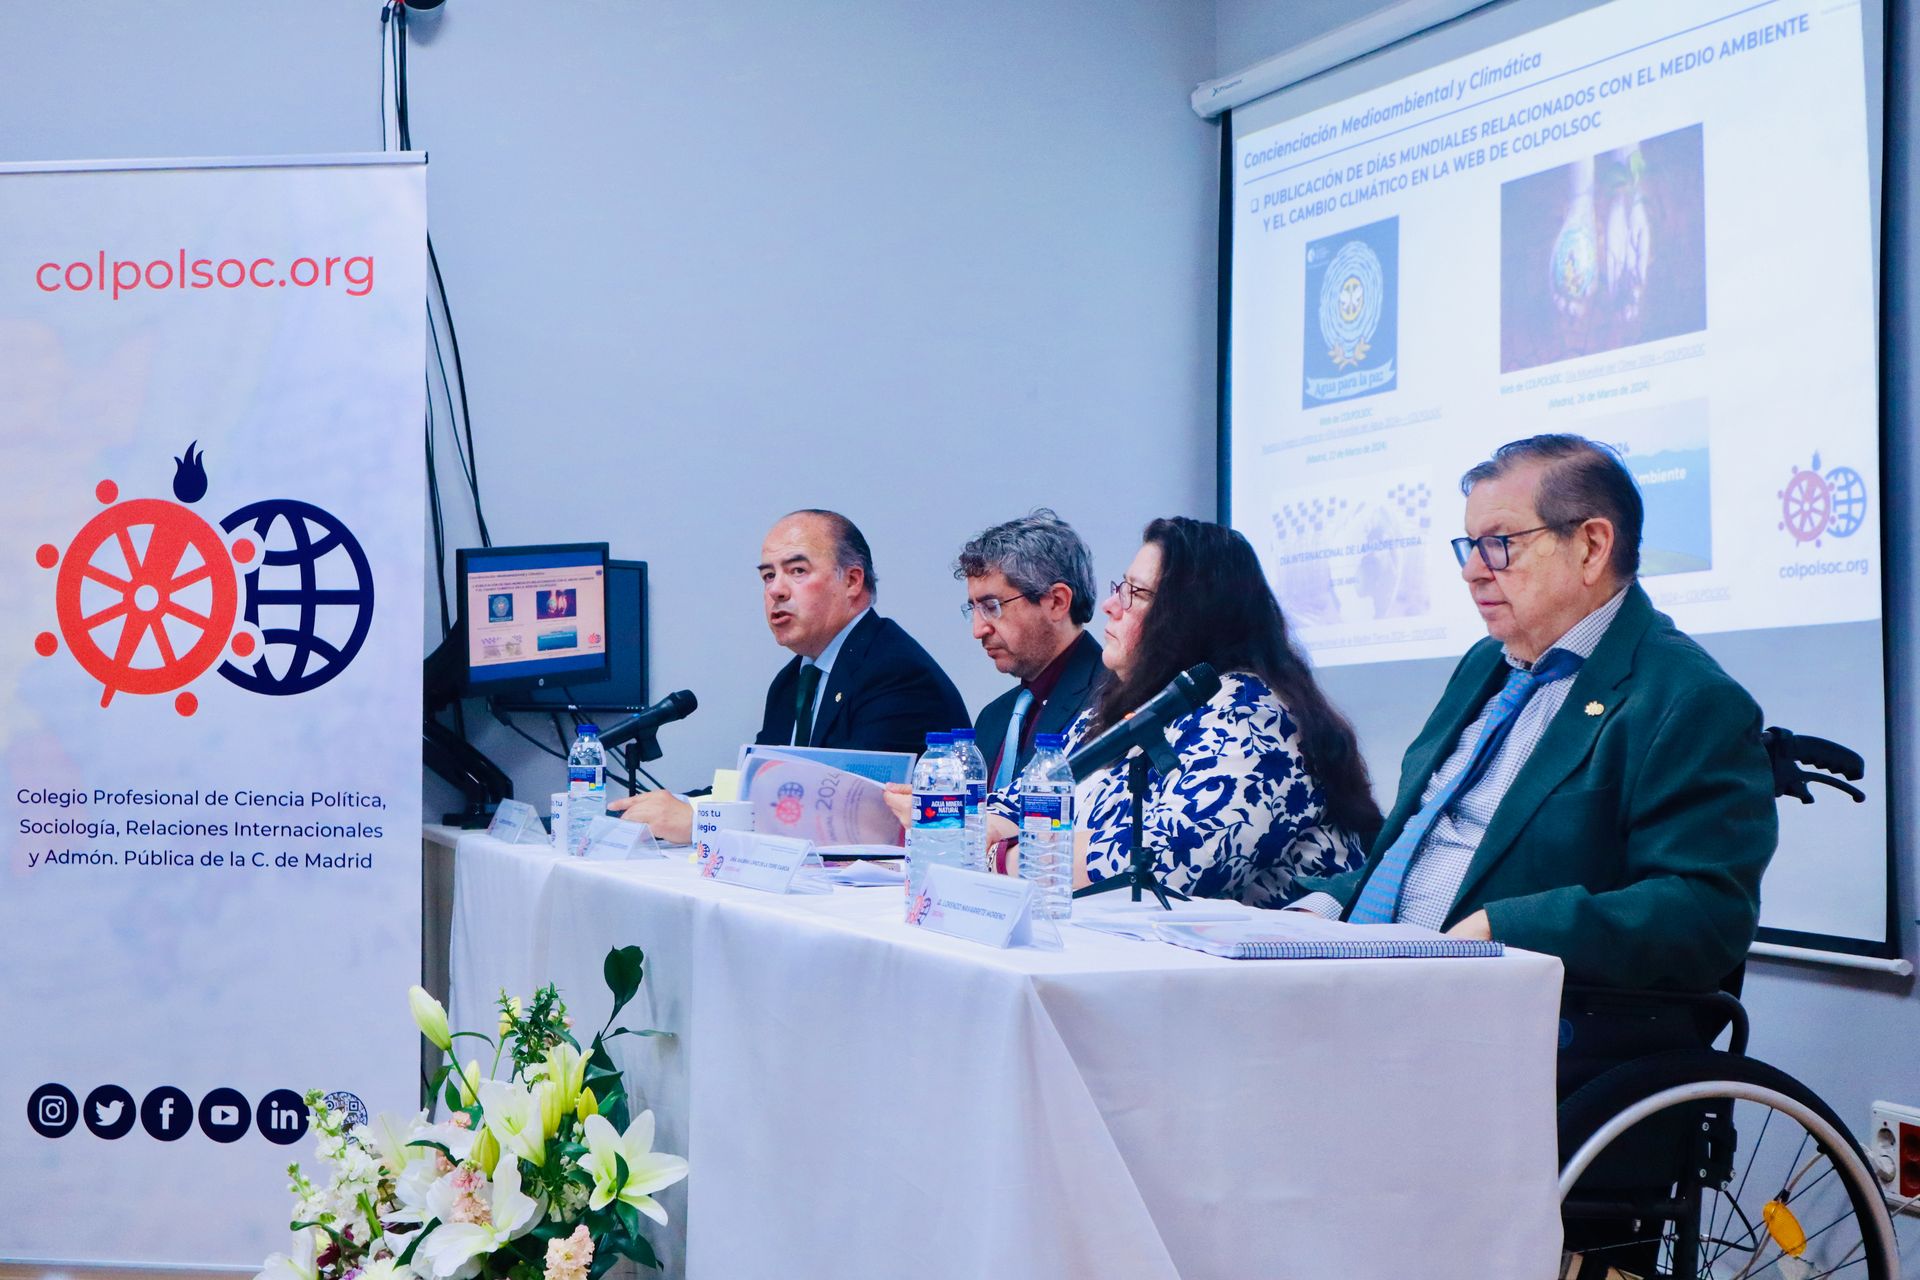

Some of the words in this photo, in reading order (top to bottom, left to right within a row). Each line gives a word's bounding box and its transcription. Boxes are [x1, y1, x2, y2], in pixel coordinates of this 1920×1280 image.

[1244, 123, 1337, 169] Concienciación
[1341, 80, 1455, 136] Medioambiental
[1456, 81, 1466, 101] y
[1469, 52, 1542, 91] Climática
[1263, 168, 1343, 209] PUBLICACIÓN
[1346, 165, 1363, 183] DE
[1366, 151, 1396, 176] DÍAS
[1399, 125, 1478, 164] MUNDIALES
[1481, 86, 1596, 139] RELACIONADOS
[1599, 72, 1633, 98] CON
[1638, 66, 1656, 87] EL
[1659, 46, 1715, 80] MEDIO
[1719, 13, 1810, 60] AMBIENTE
[1263, 217, 1271, 232] Y
[1272, 213, 1287, 228] EL
[1288, 196, 1337, 223] CAMBIO
[1339, 172, 1408, 209] CLIMÁTICO
[1411, 166, 1429, 186] EN
[1432, 162, 1450, 181] LA
[1452, 147, 1486, 173] WEB
[1489, 140, 1509, 160] DE
[1512, 111, 1603, 154] COLPOLSOC
[36, 248, 374, 301] colpolsoc.org
[1316, 382, 1336, 398] Agua
[1337, 377, 1357, 394] para
[1360, 371, 1367, 386] la
[1369, 371, 1384, 388] paz
[1636, 467, 1688, 486] mbiente
[1779, 558, 1869, 582] colpolsoc.org
[17, 788, 88, 808] Colegio
[93, 789, 199, 807] Profesional
[204, 790, 229, 806] de
[234, 790, 305, 807] Ciencia
[310, 791, 387, 810] Política,
[931, 800, 945, 808] AGUA
[937, 806, 960, 814] NATURAL
[710, 809, 721, 818] tu
[19, 818, 120, 838] Sociología,
[126, 820, 228, 837] Relaciones
[234, 821, 384, 839] Internacionales
[28, 852, 40, 868] y
[44, 849, 119, 866] Admón.
[124, 850, 195, 867] Pública
[200, 851, 224, 867] de
[230, 851, 246, 867] la
[251, 852, 269, 868] C.
[275, 852, 298, 868] de
[305, 852, 372, 869] Madrid
[270, 1100, 299, 1130] in
